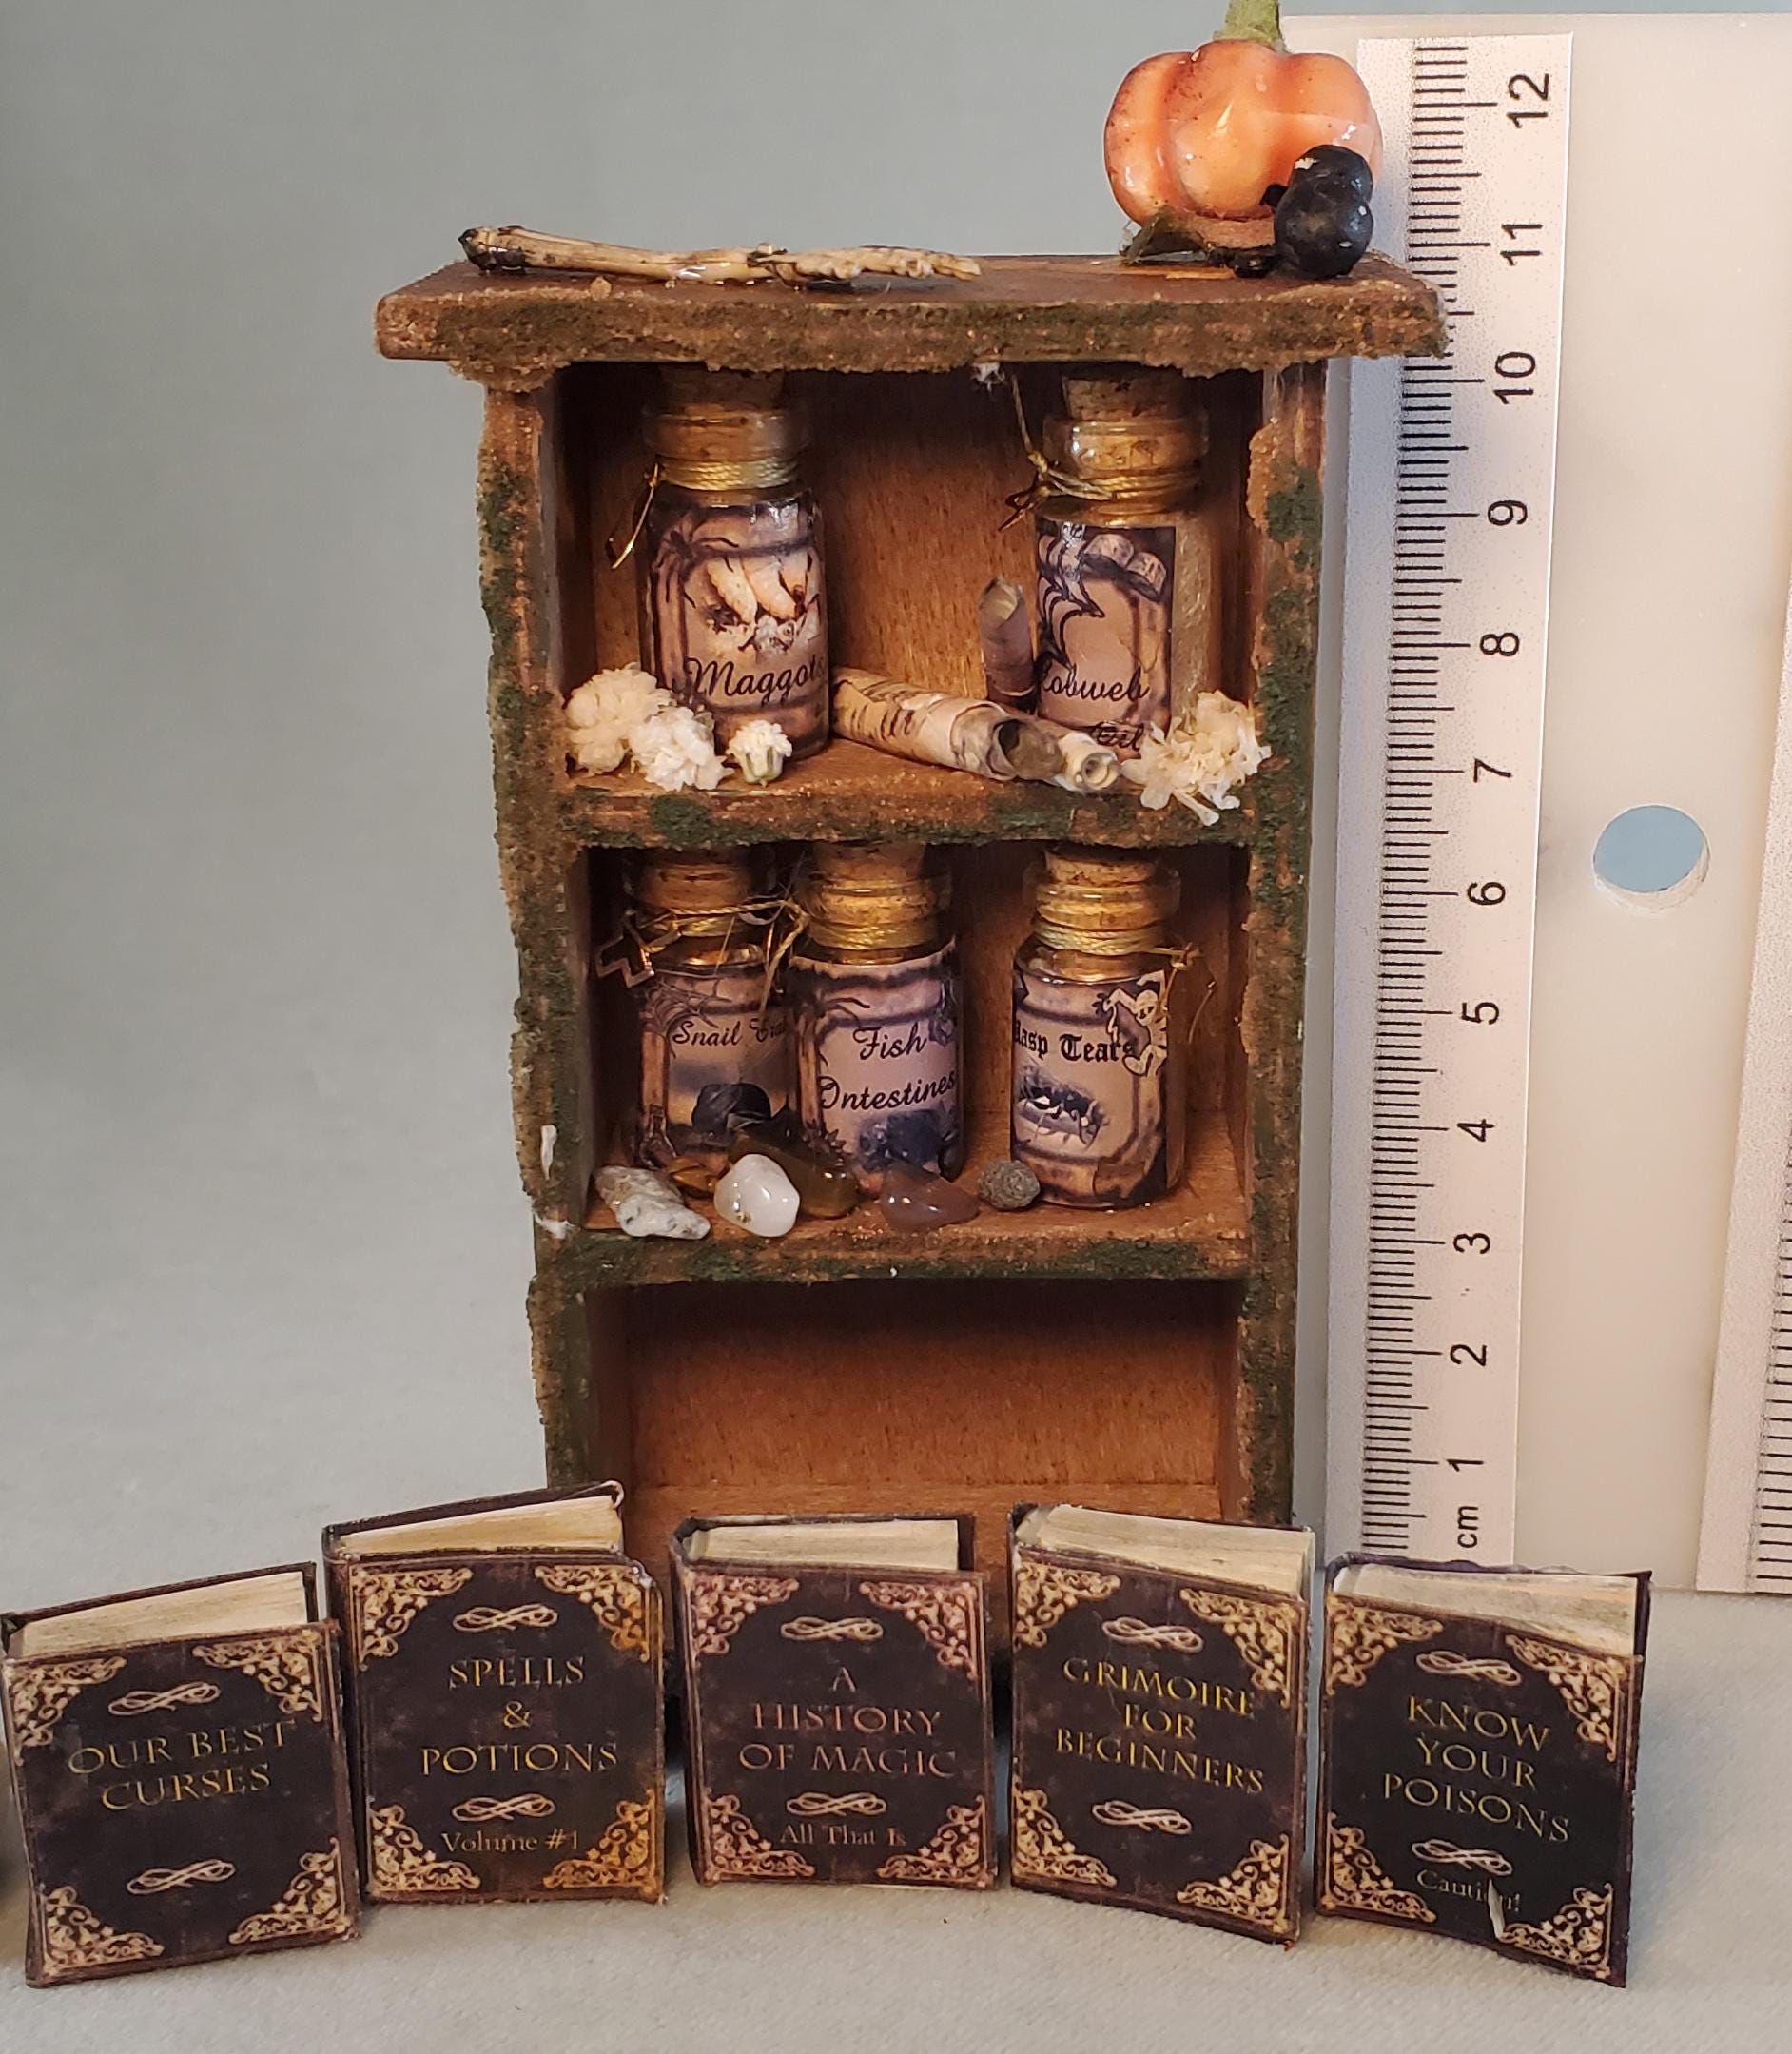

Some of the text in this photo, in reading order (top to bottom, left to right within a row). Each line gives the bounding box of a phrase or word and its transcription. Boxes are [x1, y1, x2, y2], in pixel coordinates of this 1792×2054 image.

[1507, 72, 1550, 128] 12
[1499, 221, 1545, 266] 11
[1494, 351, 1537, 405] 10
[1487, 499, 1529, 527] 9
[1479, 632, 1521, 656] 8
[1044, 664, 1150, 702] obweb
[1473, 759, 1512, 784] 7
[1468, 880, 1507, 906] 6
[1462, 1000, 1501, 1025] 5
[672, 1020, 743, 1047] Snail
[853, 1023, 928, 1061] Fish
[1059, 1033, 1135, 1063] Tears
[1457, 1117, 1494, 1143] 4
[1453, 1231, 1490, 1254] 3
[1450, 1343, 1488, 1367] 2
[1447, 1457, 1484, 1471] 1
[1456, 1504, 1479, 1550] cm
[448, 1655, 585, 1691] SPELLS
[831, 1666, 857, 1692] A
[1062, 1656, 1256, 1717] GRIMOIRE
[502, 1701, 532, 1729] &
[754, 1702, 942, 1737] HISTORY
[1123, 1702, 1198, 1742] FOR
[1407, 1695, 1550, 1752] KNOW
[68, 1718, 297, 1774] OUR BEST
[420, 1742, 618, 1776] POTIONS
[739, 1743, 957, 1778] OF MAGIC
[1055, 1727, 1265, 1795] BEGINNERS
[1414, 1736, 1538, 1790] YOUR
[101, 1762, 273, 1810] CURSES
[1382, 1772, 1570, 1844] POISONS
[441, 1829, 579, 1853] Volume #1
[780, 1824, 906, 1848] All That Is
